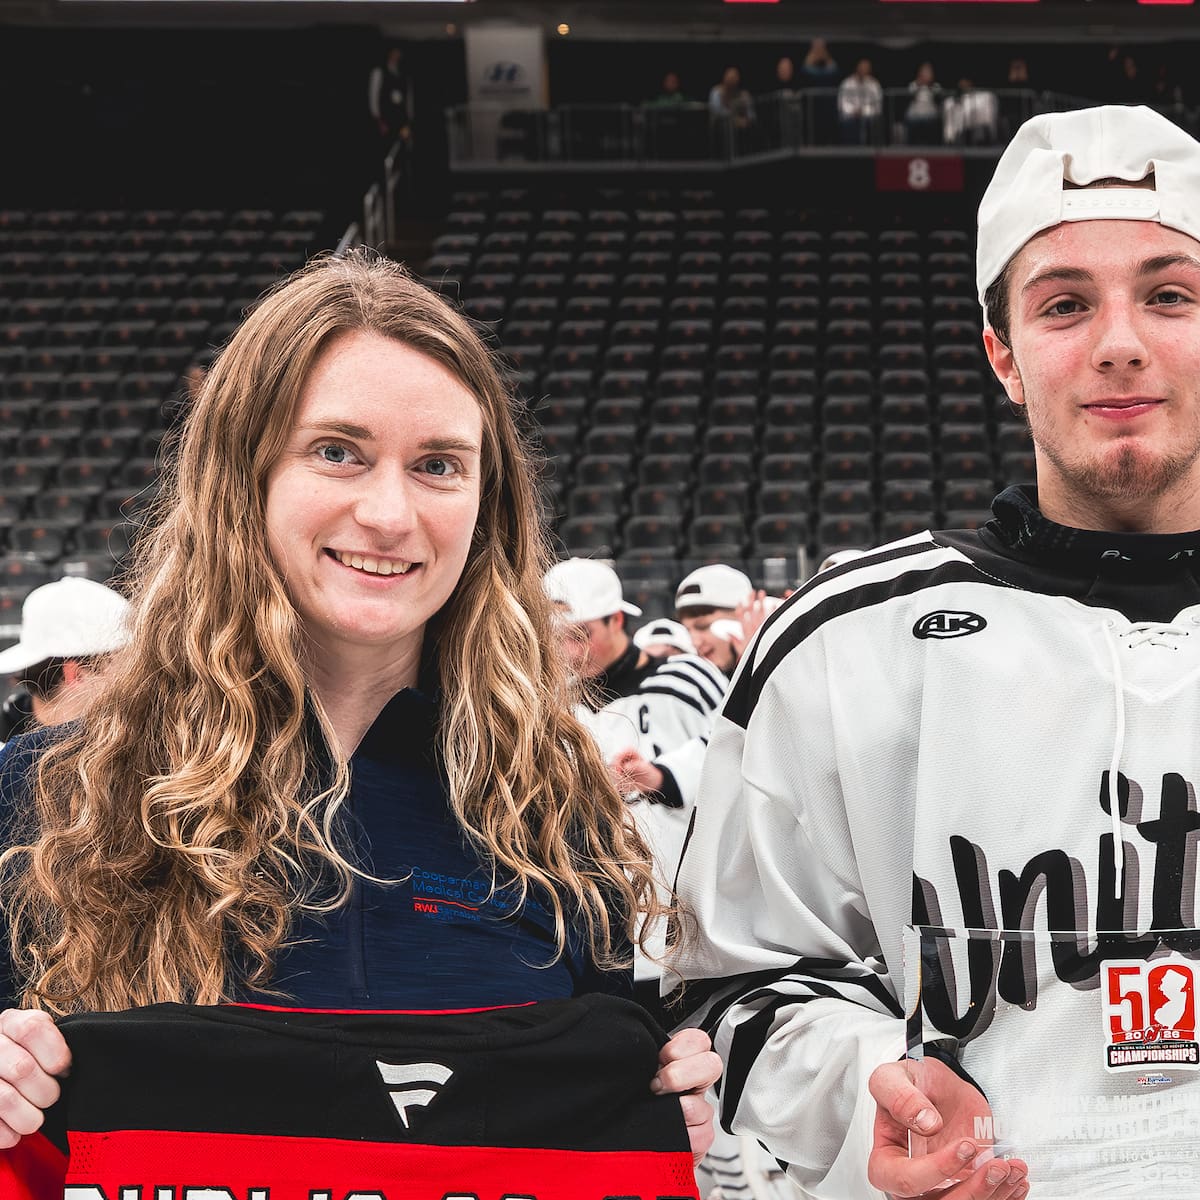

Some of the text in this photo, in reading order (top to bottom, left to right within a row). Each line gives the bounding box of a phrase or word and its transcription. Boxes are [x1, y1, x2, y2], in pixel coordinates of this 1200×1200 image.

[908, 159, 930, 189] 8
[639, 704, 649, 734] C
[1108, 965, 1195, 1033] 50
[1110, 1047, 1197, 1065] CHAMPIONSHIPS
